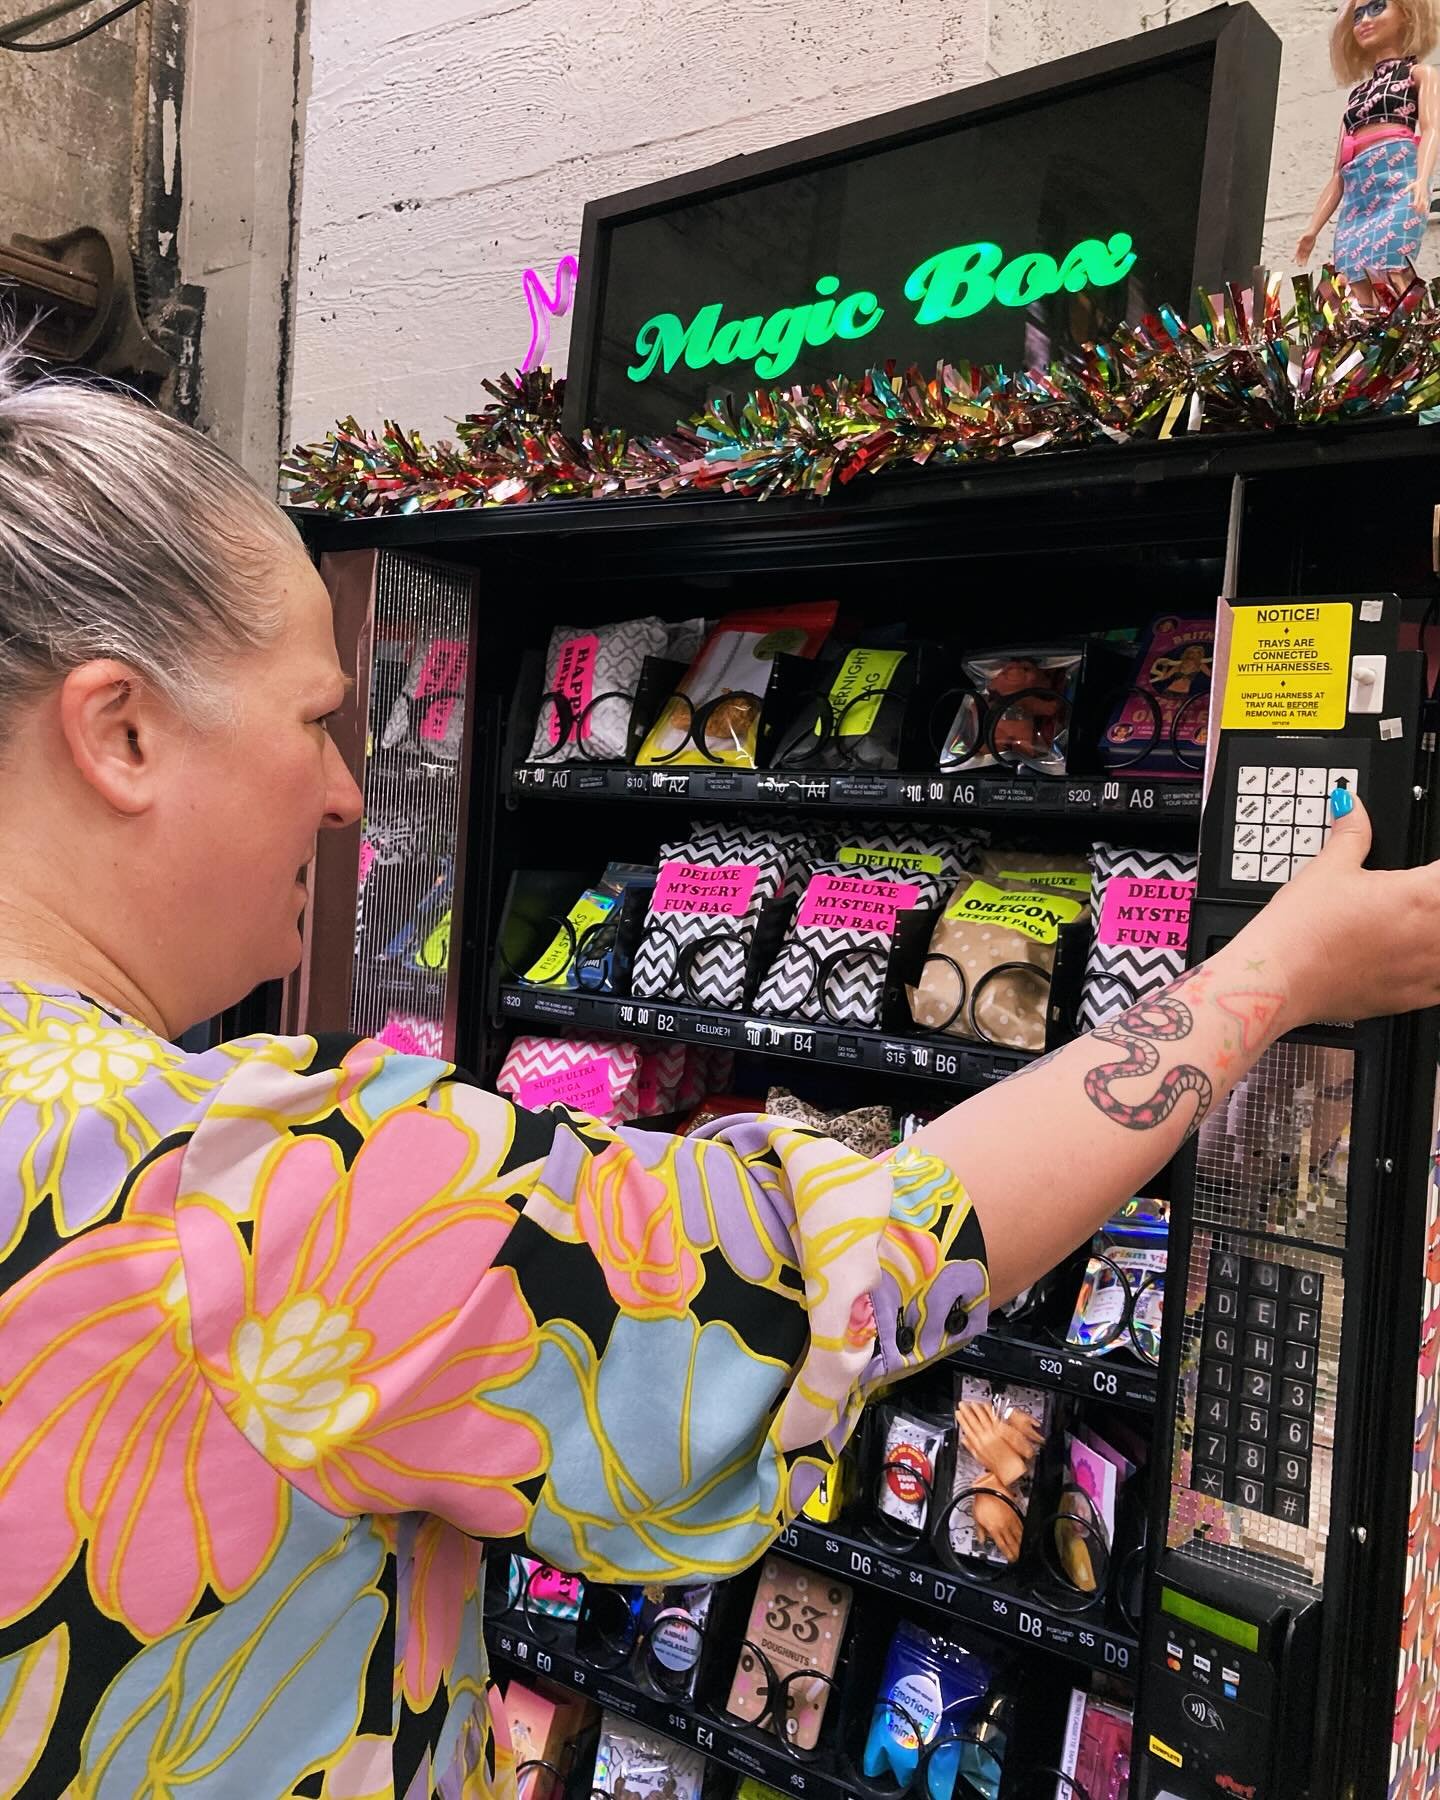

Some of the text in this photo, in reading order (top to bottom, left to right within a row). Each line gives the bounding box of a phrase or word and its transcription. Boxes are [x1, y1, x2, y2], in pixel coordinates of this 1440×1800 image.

[628, 233, 1137, 382] Magic Box
[1257, 608, 1320, 622] NOTICE!
[1258, 638, 1315, 648] TRAYS ARE
[1253, 650, 1318, 660] CONNECTED
[1238, 663, 1333, 672] WITH HARNESSES.
[831, 650, 872, 730] VERNIGHT
[1241, 692, 1273, 700] UNPLUG
[552, 773, 567, 788] A0
[669, 778, 686, 793] A2
[807, 781, 826, 798] A4
[953, 785, 975, 804] A6
[1130, 788, 1154, 809] A8
[855, 853, 923, 871] DELUXE
[679, 867, 741, 881] DELUXE
[666, 882, 743, 897] MYSTERY
[827, 879, 900, 899] DELUXE
[1128, 883, 1197, 900] DELUX
[664, 899, 732, 913] FUN BAG
[815, 895, 900, 915] MYSTERY
[964, 899, 1064, 927] OREGON
[1117, 906, 1190, 923] MYSTE
[811, 913, 889, 931] FUN BAG
[1011, 918, 1047, 938] PACK
[1116, 927, 1161, 944] FUN
[540, 949, 562, 970] FISH
[658, 1013, 674, 1032] B2
[794, 1034, 812, 1053] B4
[936, 1054, 957, 1074] B6
[533, 1075, 563, 1090] SUPER
[1220, 1259, 1233, 1278] A
[1300, 1275, 1313, 1295] C
[1218, 1294, 1311, 1332] D E F
[1215, 1330, 1307, 1369] G H J
[1040, 1358, 1118, 1394] $20 C8
[1215, 1367, 1304, 1406] 1 2 3
[1210, 1402, 1301, 1443] 4 5 6
[1208, 1437, 1299, 1479] 7 8 9
[1244, 1484, 1256, 1504] 0
[825, 1540, 839, 1553] $5
[851, 1551, 871, 1575] D6
[910, 1570, 1042, 1638] $4 D7 $6 D8
[766, 1594, 828, 1644] 33
[761, 1638, 811, 1667] DOUGHNUTS
[1079, 1632, 1129, 1668] $5 D9
[536, 1651, 585, 1685] E0 E2
[669, 1714, 687, 1730] $15
[697, 1727, 714, 1750] E4
